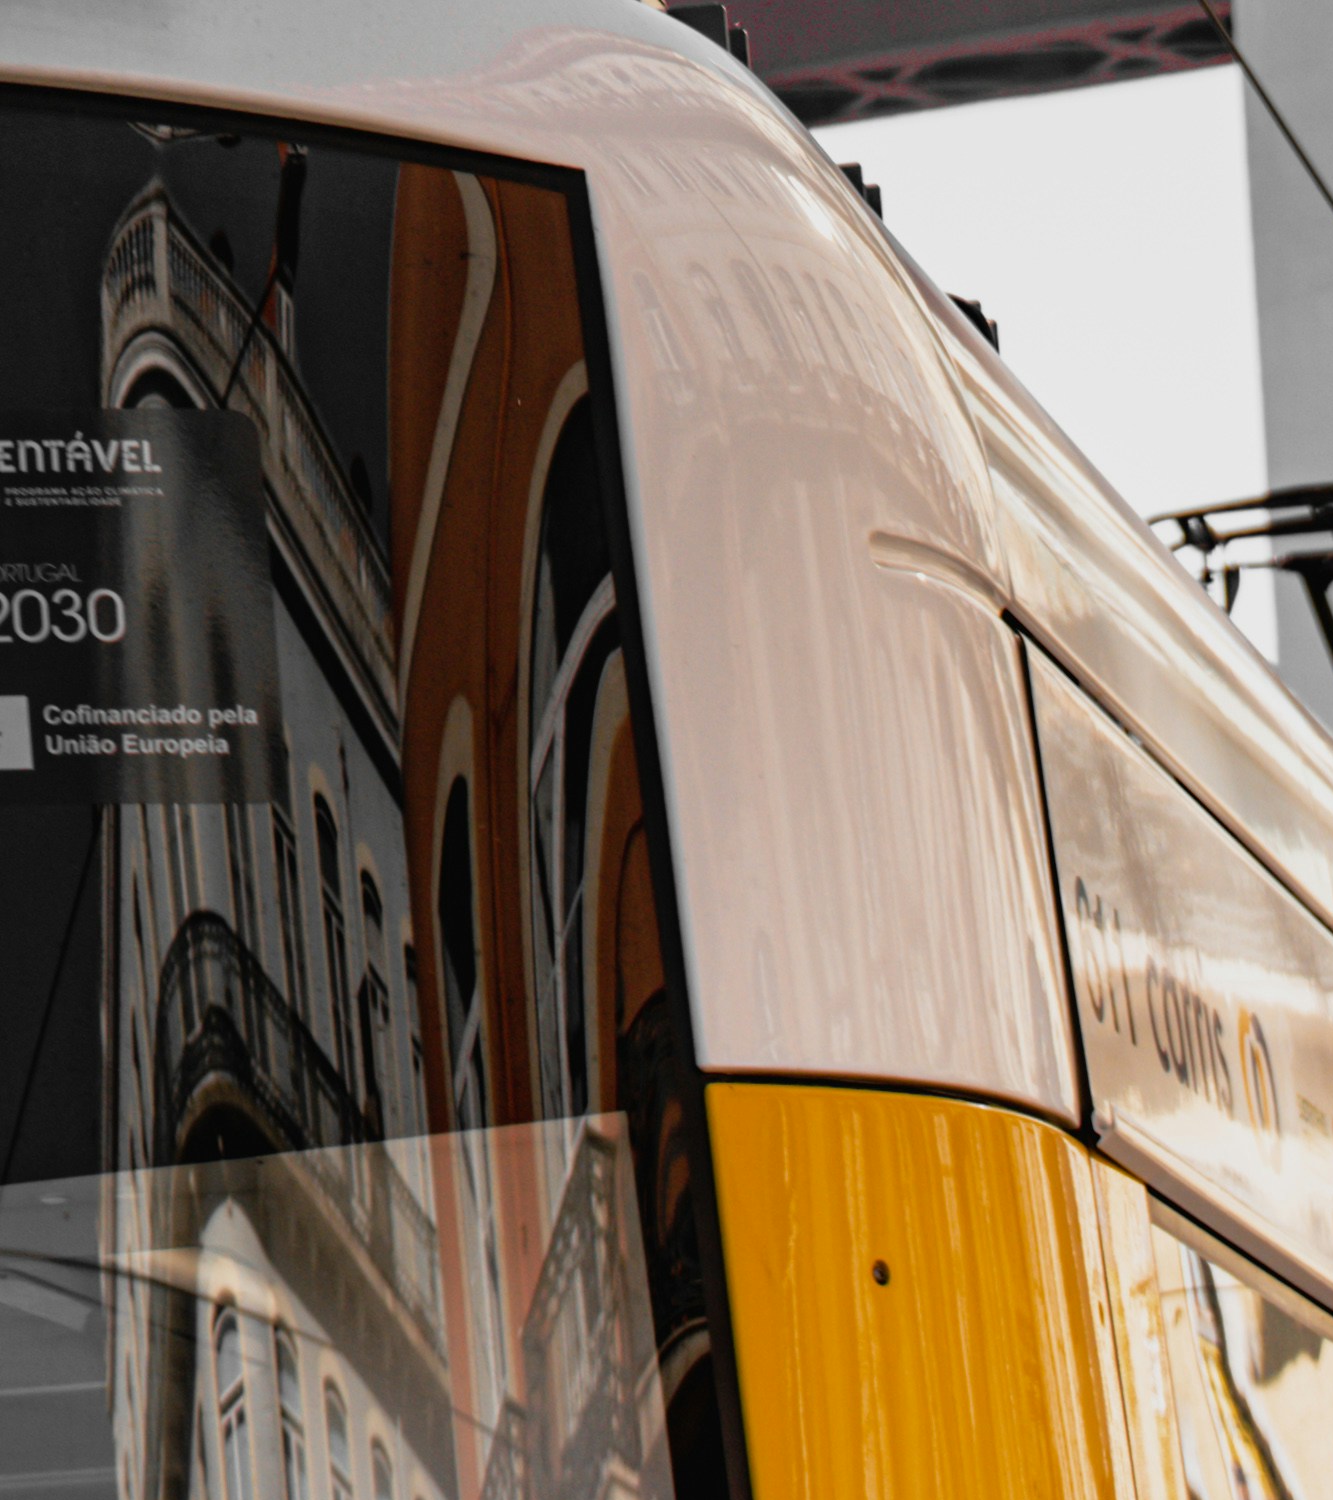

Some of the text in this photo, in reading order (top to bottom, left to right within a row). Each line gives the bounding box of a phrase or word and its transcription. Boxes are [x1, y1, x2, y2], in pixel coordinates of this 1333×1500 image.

[43, 705, 258, 729] Cofinanciado pela
[45, 734, 230, 758] União Europeia
